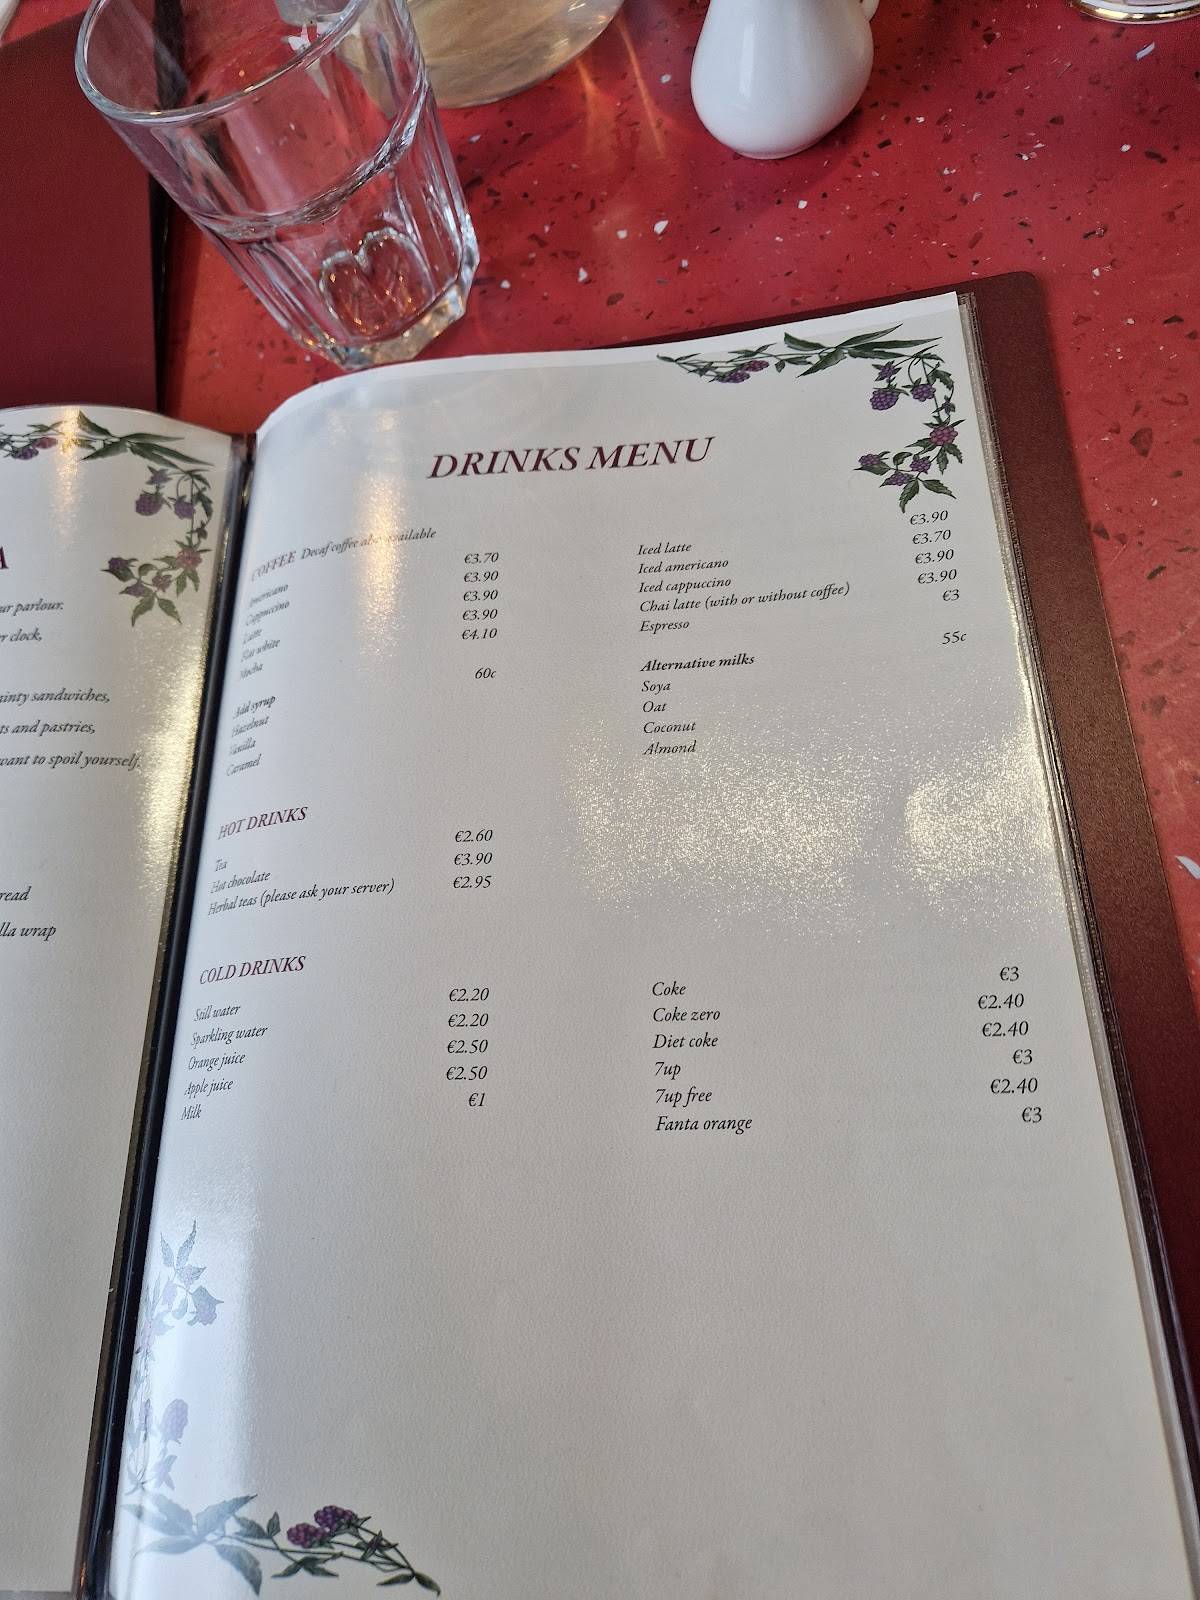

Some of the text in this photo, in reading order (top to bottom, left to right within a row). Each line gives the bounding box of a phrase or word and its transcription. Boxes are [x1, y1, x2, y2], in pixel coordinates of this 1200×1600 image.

[426, 436, 716, 479] DRINKS MENU
[909, 510, 948, 526] €3.90
[912, 529, 951, 545] €3.70
[637, 541, 692, 556] Iced latte
[914, 548, 954, 564] €3.90
[251, 550, 297, 582] COFFEE
[300, 541, 332, 560] Decaf
[331, 537, 359, 554] coffee
[464, 552, 499, 565] €3.70
[637, 558, 729, 575] Iced americano
[463, 571, 499, 583] €3.90
[917, 568, 957, 585] €3.90
[638, 577, 732, 594] Iced cappuccino
[463, 590, 499, 602] €3.90
[639, 581, 851, 613] Chai latte (with or without coffee)
[942, 589, 960, 602] €3
[13, 598, 64, 617] parlour.
[462, 608, 498, 621] €3.90
[461, 628, 498, 640] €4.10
[639, 619, 690, 635] Espresso
[9, 628, 43, 643] clock,
[941, 631, 967, 645] 55c
[640, 653, 756, 672] Alternative milks
[474, 667, 497, 679] 60c
[33, 687, 111, 704] sandwiches,
[641, 680, 672, 695] Soya
[250, 695, 276, 714] syrup
[642, 701, 667, 713] Oat
[11, 719, 42, 735] and
[39, 723, 96, 737] pastries,
[643, 721, 697, 735] Coconut
[644, 739, 697, 756] Almond
[33, 754, 47, 766] to
[49, 751, 83, 770] spoil
[225, 752, 263, 777] Caramel
[217, 806, 308, 841] HOT DRINKS
[455, 829, 493, 843] €2.60
[214, 857, 228, 873] Tea
[454, 852, 493, 866] €3.90
[209, 870, 272, 895] Hot chocolate
[453, 875, 492, 889] €2.95
[207, 877, 396, 917] Herbal teas (please ask your server)
[20, 926, 57, 941] wrap
[199, 955, 306, 985] COLD DRINKS
[999, 966, 1020, 982] €3
[449, 987, 490, 1002] €2.20
[652, 981, 686, 996] Coke
[978, 993, 1024, 1010] €2.40
[193, 1004, 241, 1022] Still water
[448, 1013, 489, 1028] €2.20
[652, 1006, 721, 1022] Coke zero
[982, 1020, 1029, 1038] €2.40
[190, 1025, 269, 1050] Sparkling water
[652, 1033, 718, 1049] Diet coke
[447, 1039, 488, 1054] €2.50
[187, 1052, 246, 1073] Orange juice
[1012, 1048, 1033, 1065] €3
[446, 1065, 488, 1080] €2.50
[654, 1060, 681, 1080] 7up
[184, 1078, 234, 1097] Apple juice
[990, 1077, 1038, 1095] €2.40
[468, 1092, 486, 1107] €1
[655, 1087, 713, 1108] 7up free
[180, 1104, 202, 1122] Milk
[1021, 1106, 1043, 1123] €3
[655, 1115, 752, 1136] Fanta orange
